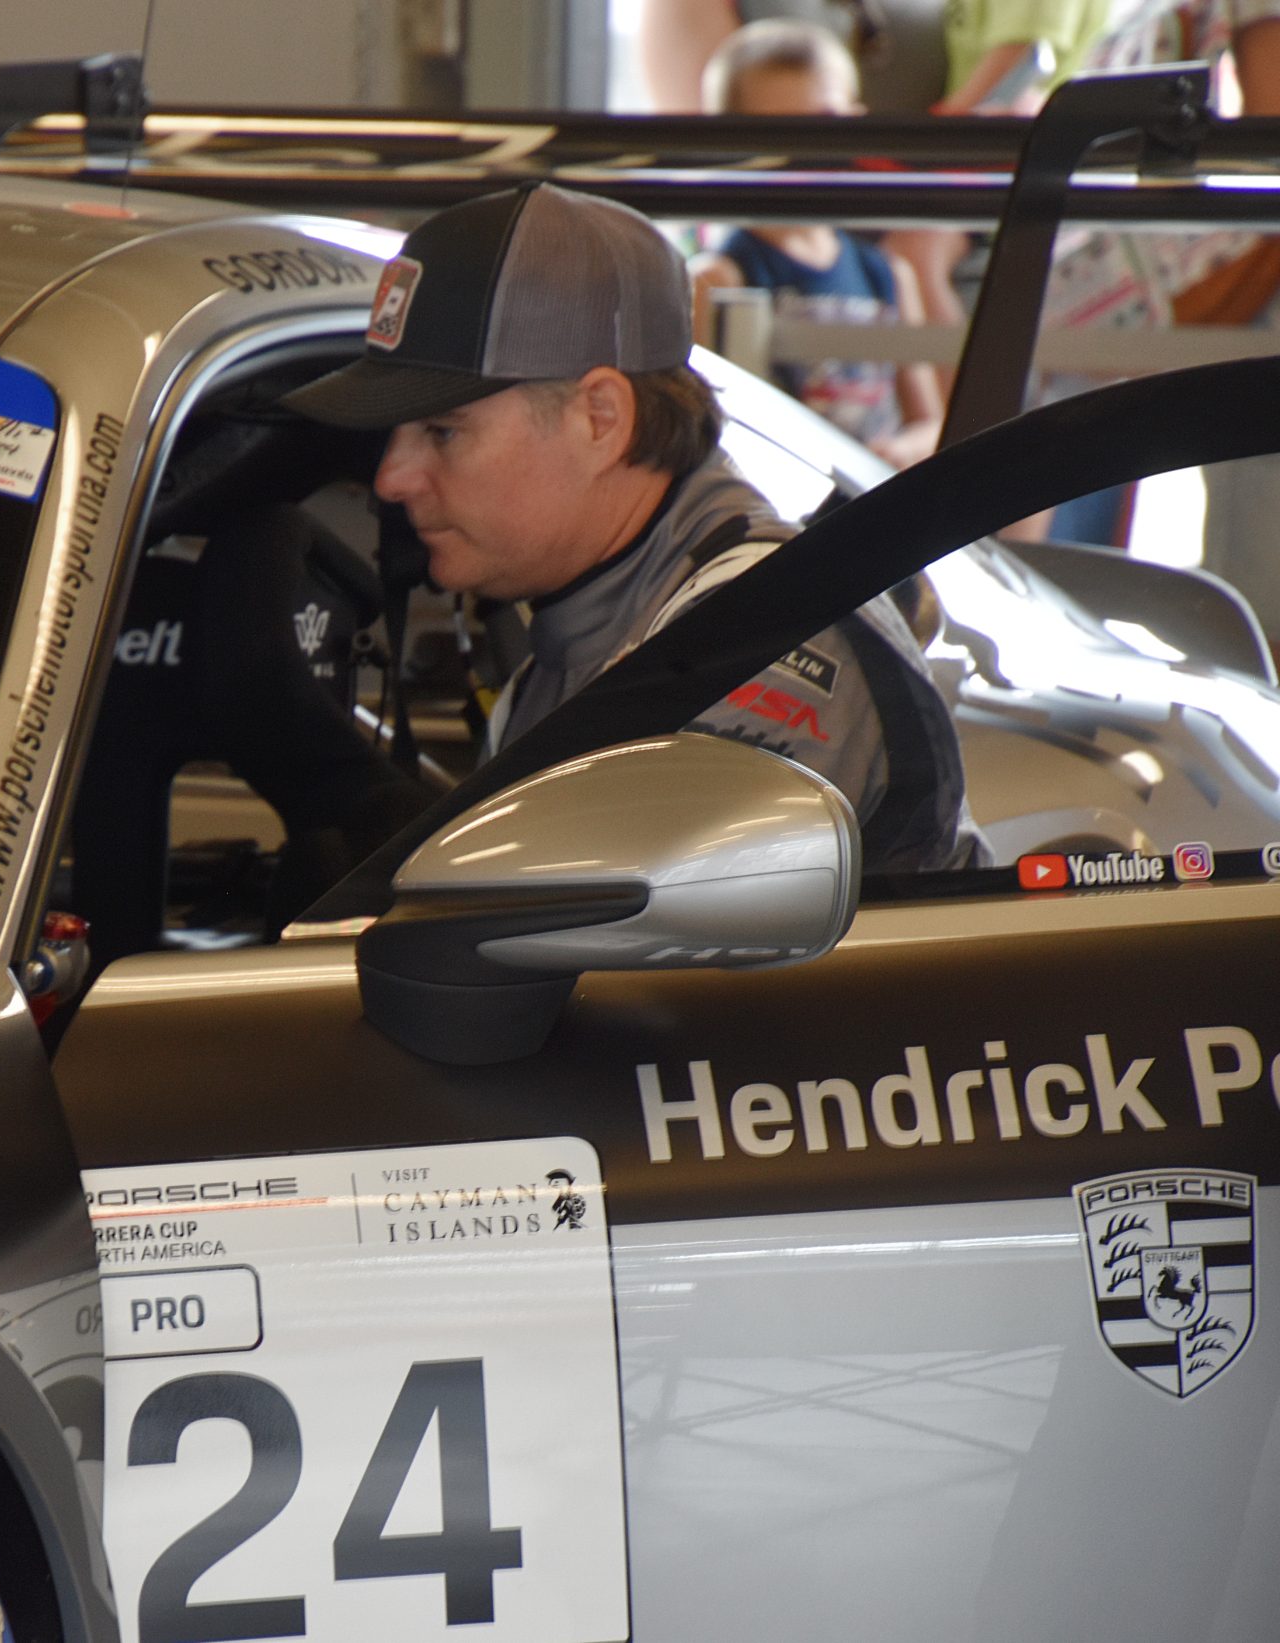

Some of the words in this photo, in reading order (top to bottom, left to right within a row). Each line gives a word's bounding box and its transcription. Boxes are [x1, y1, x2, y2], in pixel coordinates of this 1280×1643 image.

[202, 247, 367, 293] GORDON
[114, 618, 184, 666] elt
[1068, 850, 1164, 887] YouTube
[636, 1032, 1167, 1164] Hendrick
[1184, 1025, 1280, 1128] P
[382, 1167, 430, 1183] VISIT
[383, 1183, 537, 1213] CAYMAN
[1087, 1178, 1248, 1210] PORSCHE
[160, 1220, 197, 1239] CUP
[388, 1213, 542, 1243] ISLANDS
[141, 1240, 226, 1261] AMERICA
[1144, 1250, 1200, 1264] STUTTGART
[131, 1294, 206, 1332] PRO
[126, 1357, 523, 1643] 24
